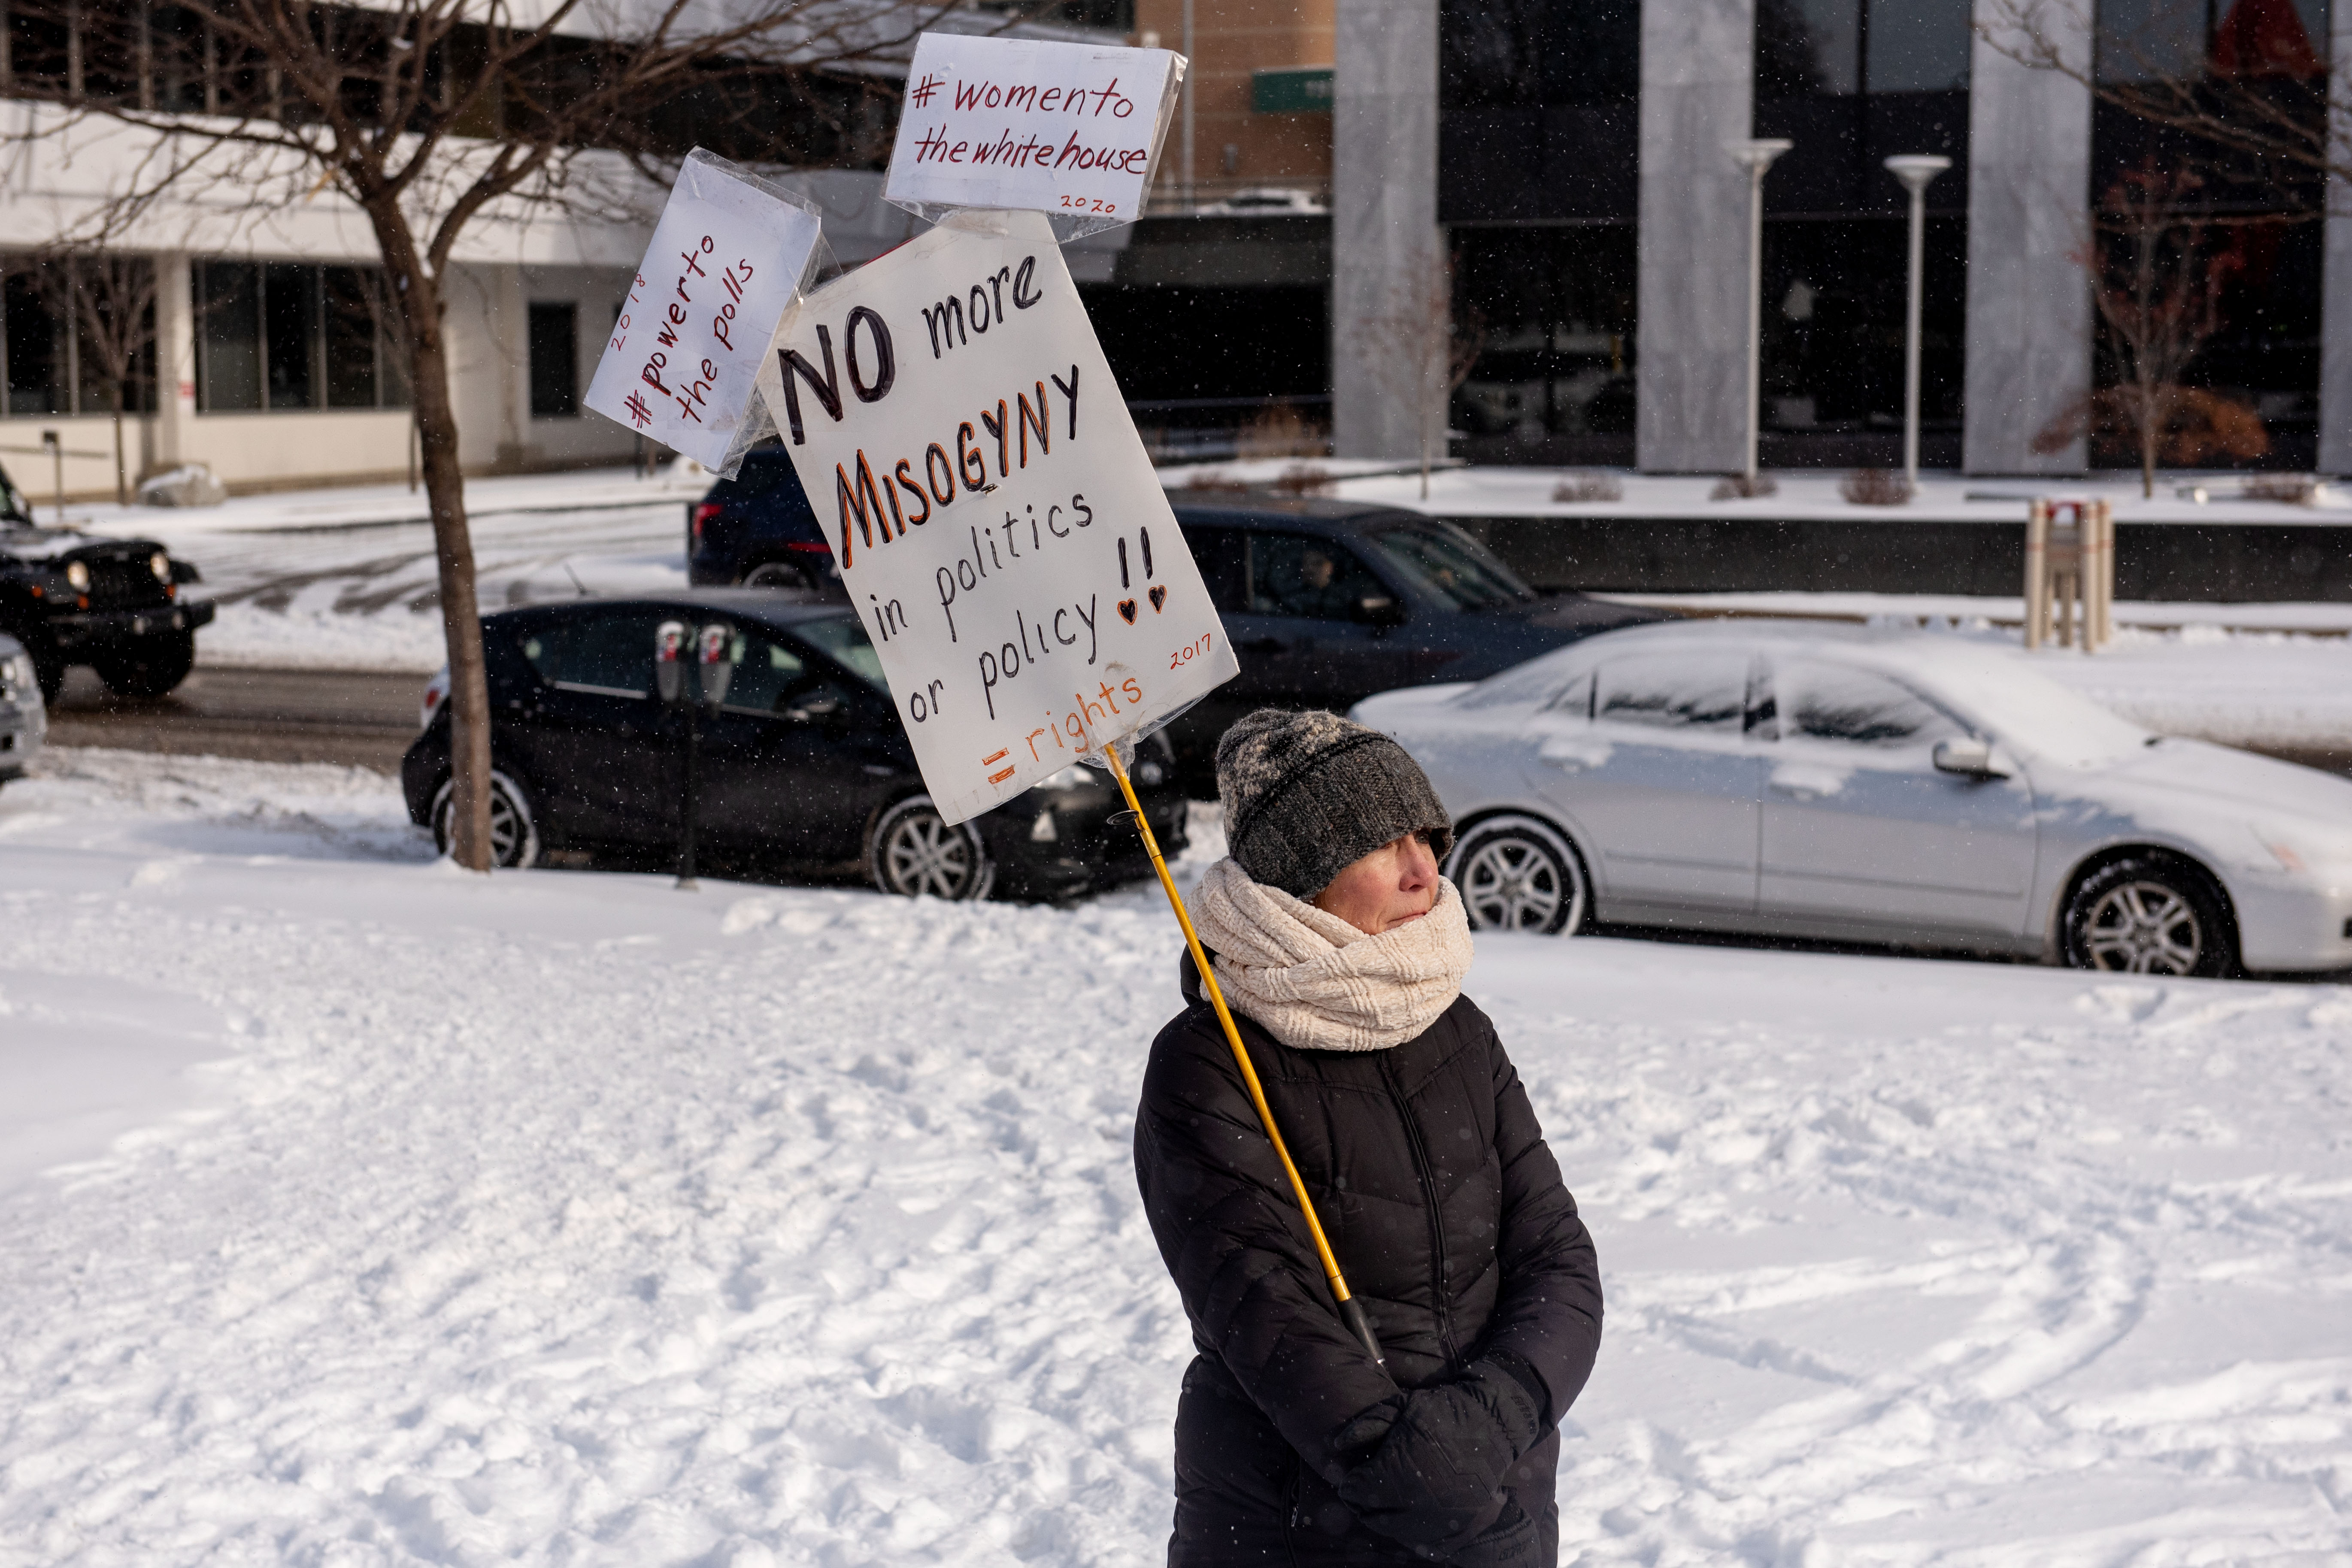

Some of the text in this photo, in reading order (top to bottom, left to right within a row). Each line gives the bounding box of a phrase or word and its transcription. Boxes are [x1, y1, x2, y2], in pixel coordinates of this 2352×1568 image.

[1061, 195, 1115, 213] 2020
[611, 274, 645, 351] 2018
[778, 256, 1043, 445] NO more
[870, 493, 1093, 642] in politics
[1170, 633, 1211, 669] 2017
[910, 679, 944, 722] or
[1025, 678, 1142, 762] rights
